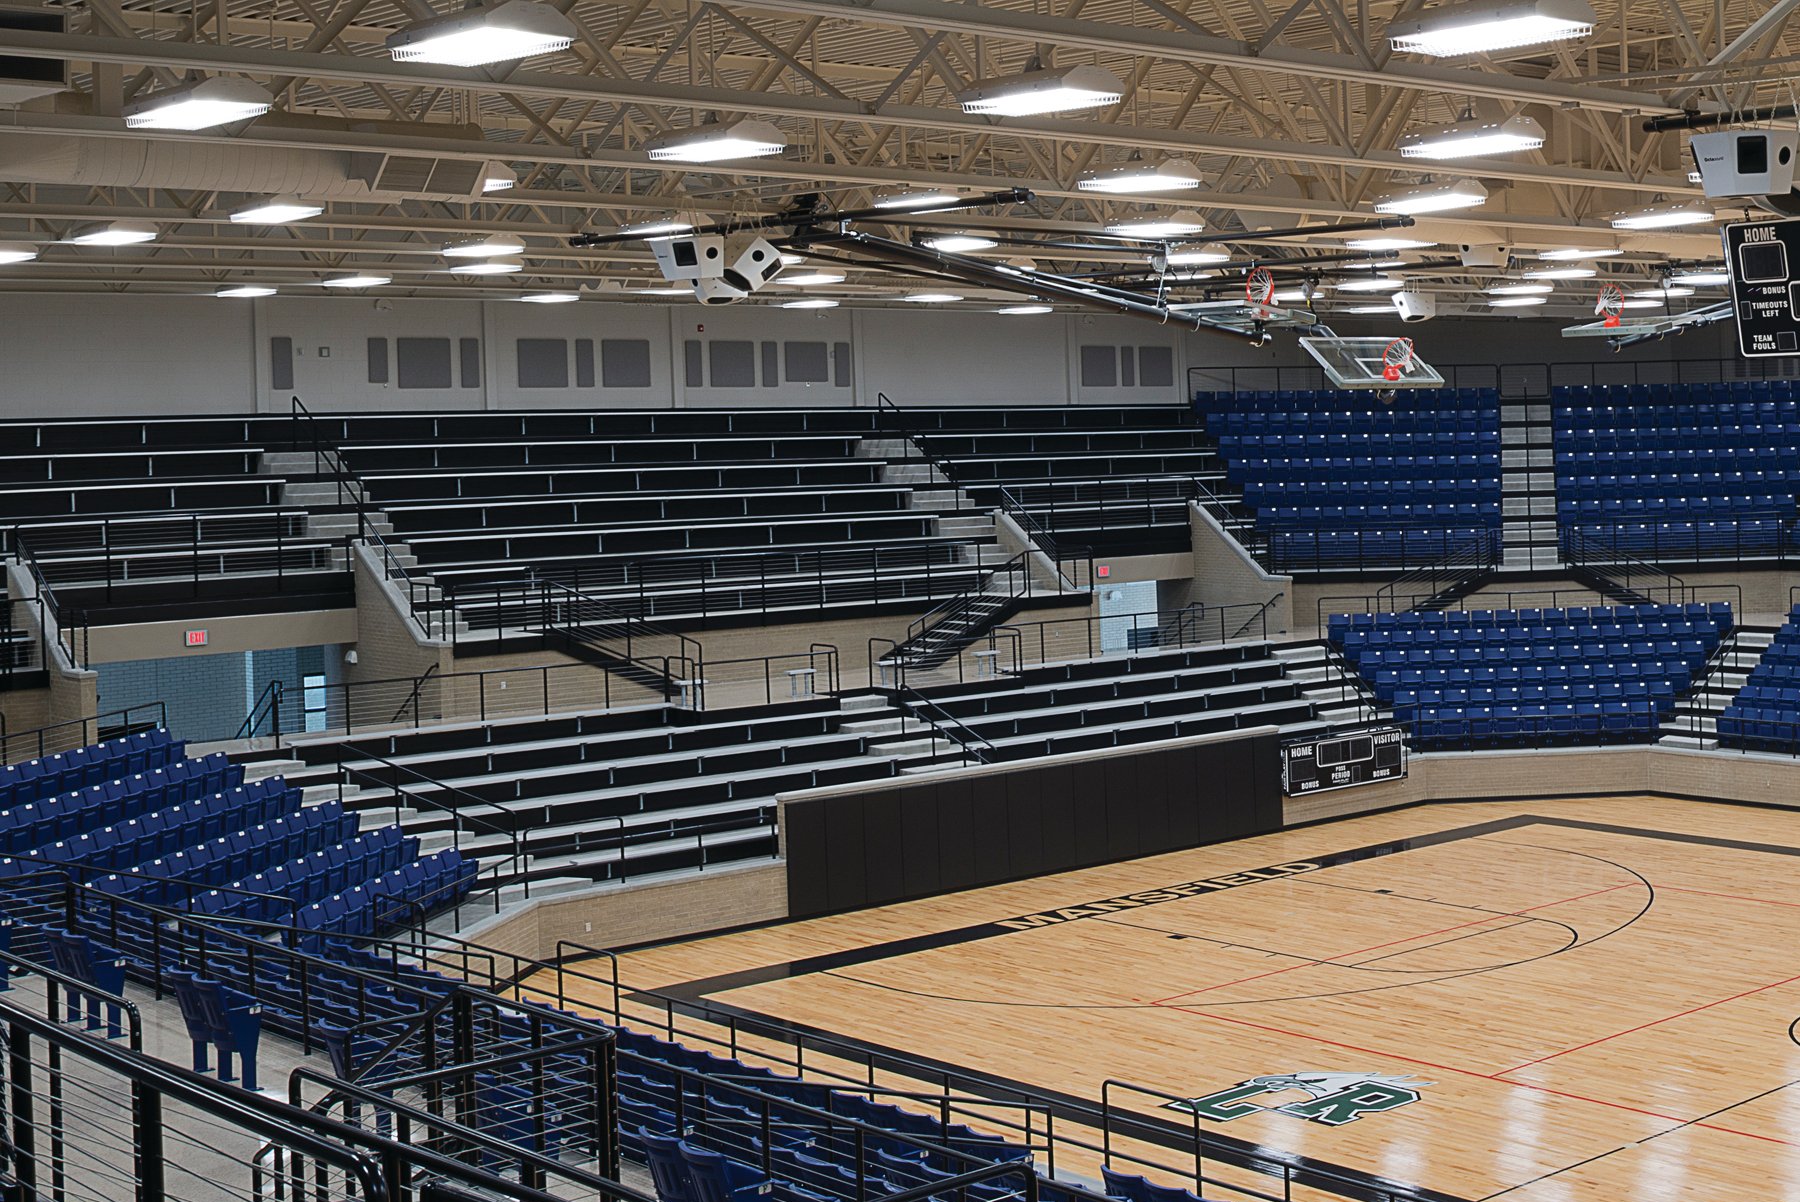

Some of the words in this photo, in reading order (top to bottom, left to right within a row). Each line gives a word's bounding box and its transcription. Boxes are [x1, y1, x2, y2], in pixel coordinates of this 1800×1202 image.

[1744, 227, 1777, 242] HOME
[1762, 286, 1786, 294] BONUS
[1752, 301, 1788, 309] TIMEOUTS
[1753, 334, 1773, 342] TEAM
[189, 631, 205, 645] EXIT
[1374, 732, 1400, 744] VISITOR
[1291, 745, 1312, 758] HOME
[1332, 770, 1350, 780] PERIOD
[1373, 768, 1390, 777] BONUS
[1301, 780, 1319, 790] BONUS
[994, 862, 1321, 931] MANSFIELD
